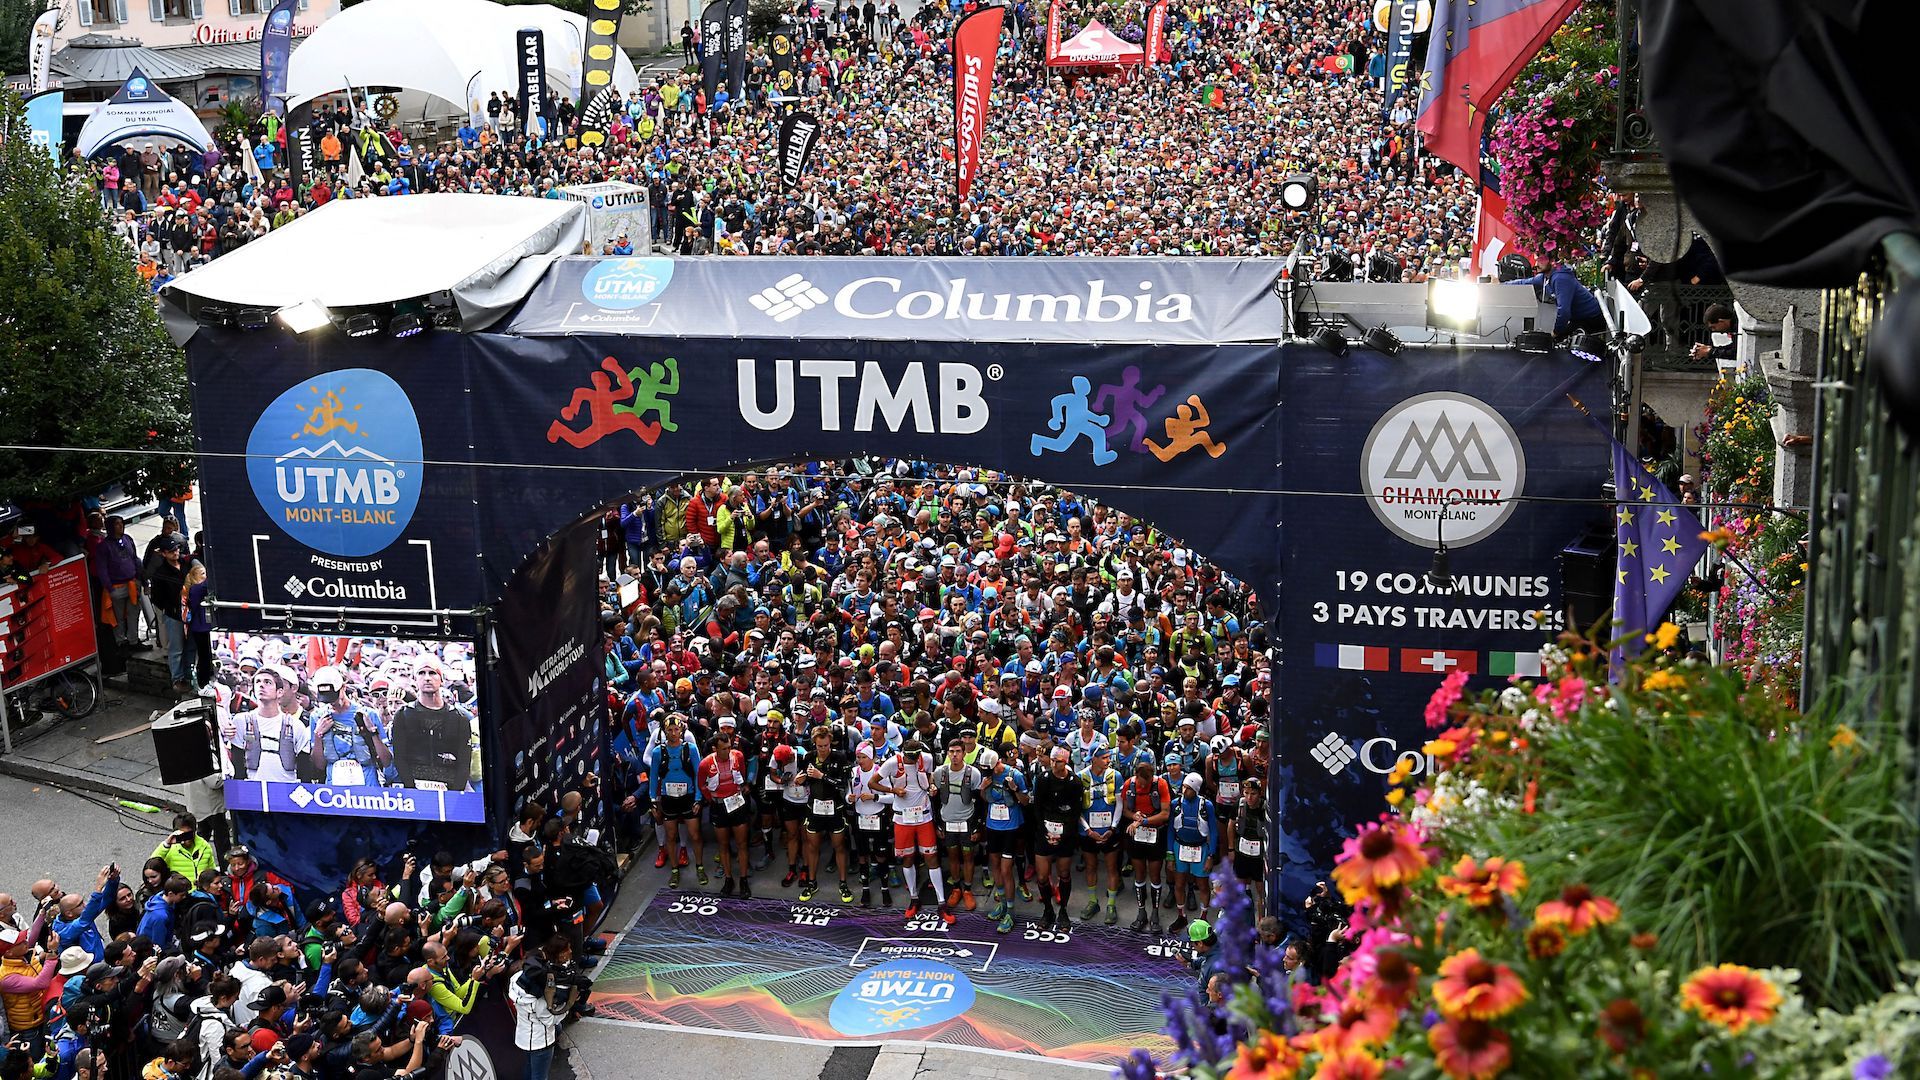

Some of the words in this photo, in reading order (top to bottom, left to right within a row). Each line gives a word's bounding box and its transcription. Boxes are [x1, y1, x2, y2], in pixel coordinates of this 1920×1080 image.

[197, 24, 242, 44] Office
[525, 36, 538, 65] BAR
[783, 120, 817, 187] CAMELBAK
[605, 191, 645, 207] UTMB
[833, 276, 1194, 324] Columbia
[1382, 486, 1502, 507] CHAMONIX
[285, 507, 397, 525] MONT-BLANC
[311, 554, 369, 573] PRESENTED
[370, 559, 384, 571] BY
[306, 576, 407, 600] Columbia
[1336, 571, 1369, 592] 19
[1312, 602, 1330, 623] 3
[1337, 602, 1407, 628] PAYS
[548, 656, 570, 682] WORLD
[568, 644, 584, 665] TOUR
[313, 787, 416, 812] Columbia
[667, 902, 718, 916] OCC
[680, 895, 722, 905] 56KM
[790, 905, 841, 917] 290KM
[793, 913, 831, 926] PTL
[906, 921, 950, 932] TDS
[1024, 930, 1071, 944] CCC
[881, 946, 955, 956] Columbia
[869, 970, 955, 981] MONT-BLANC
